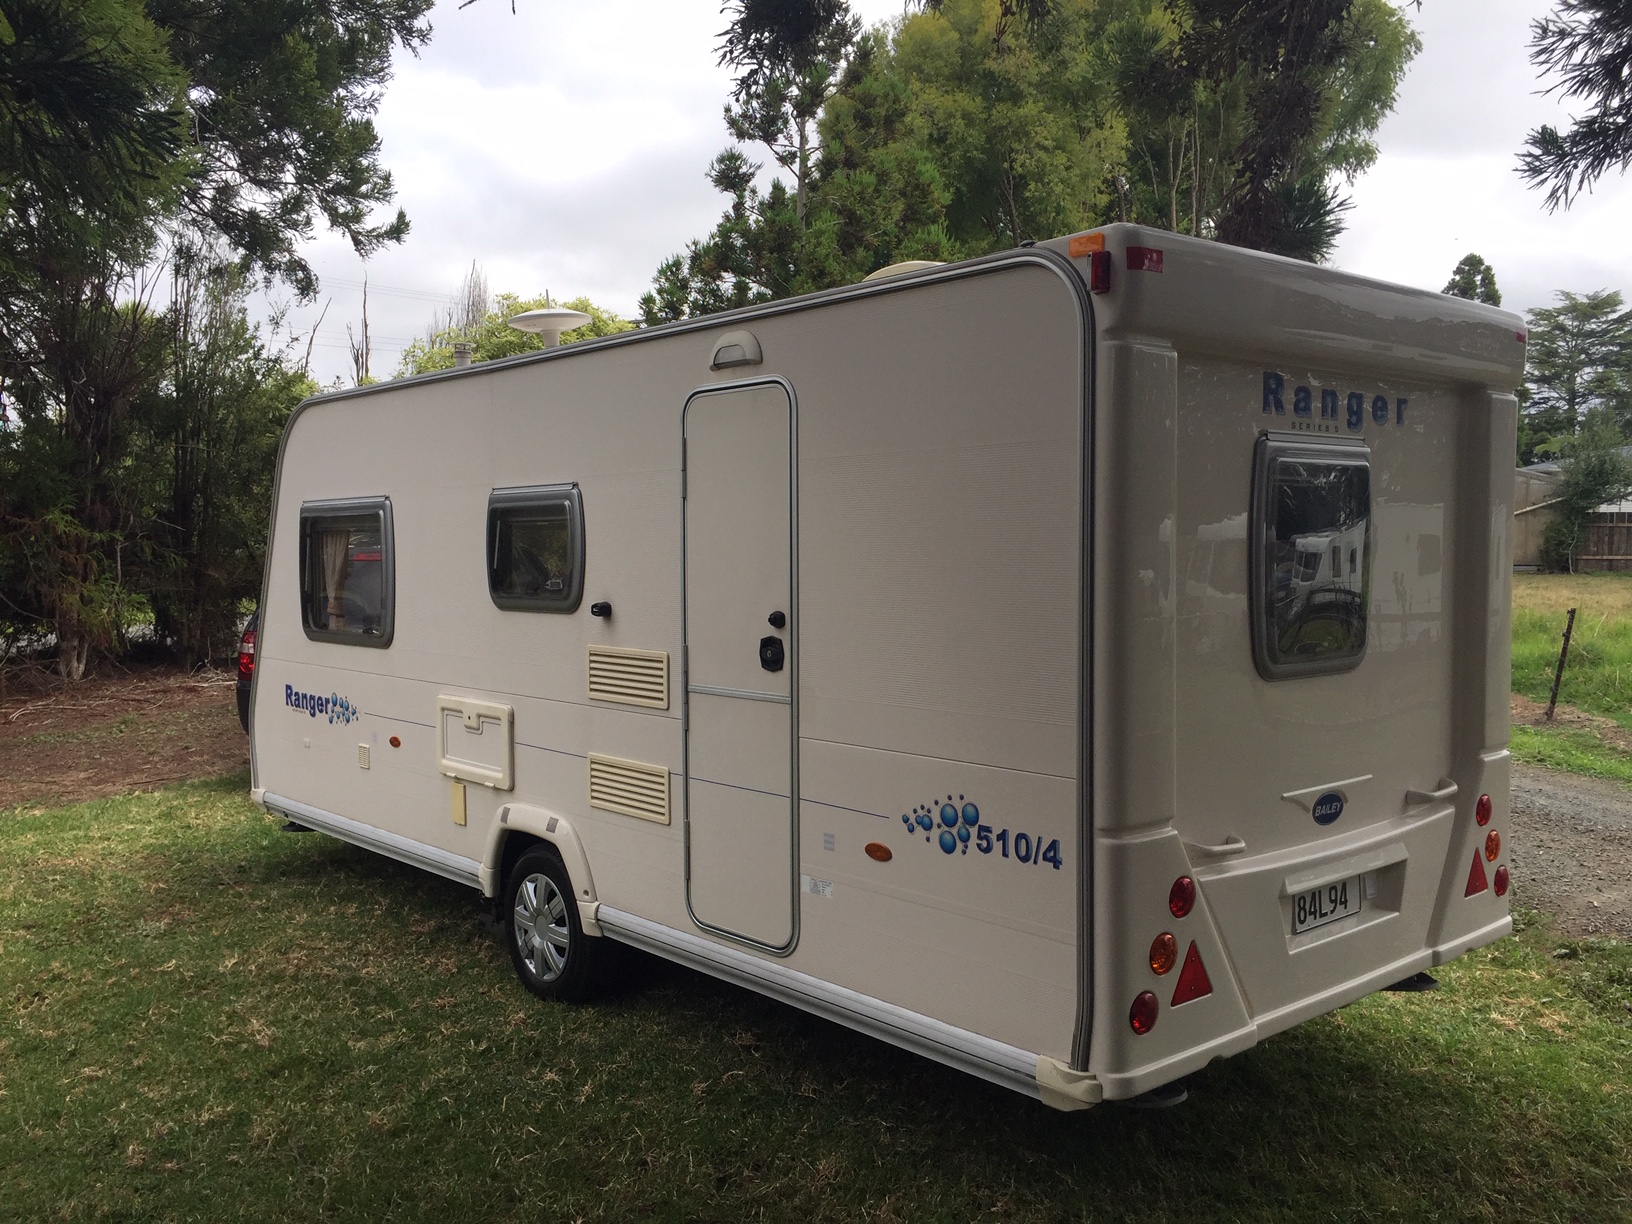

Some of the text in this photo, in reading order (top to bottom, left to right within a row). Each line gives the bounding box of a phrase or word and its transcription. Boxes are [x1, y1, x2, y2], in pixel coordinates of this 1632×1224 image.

[1262, 371, 1408, 433] Ranger
[1291, 421, 1330, 432] SERIES
[285, 684, 330, 718] Ranger
[1315, 801, 1343, 817] BAILEY
[976, 824, 1063, 870] 510/4
[1297, 882, 1349, 925] 84L94
